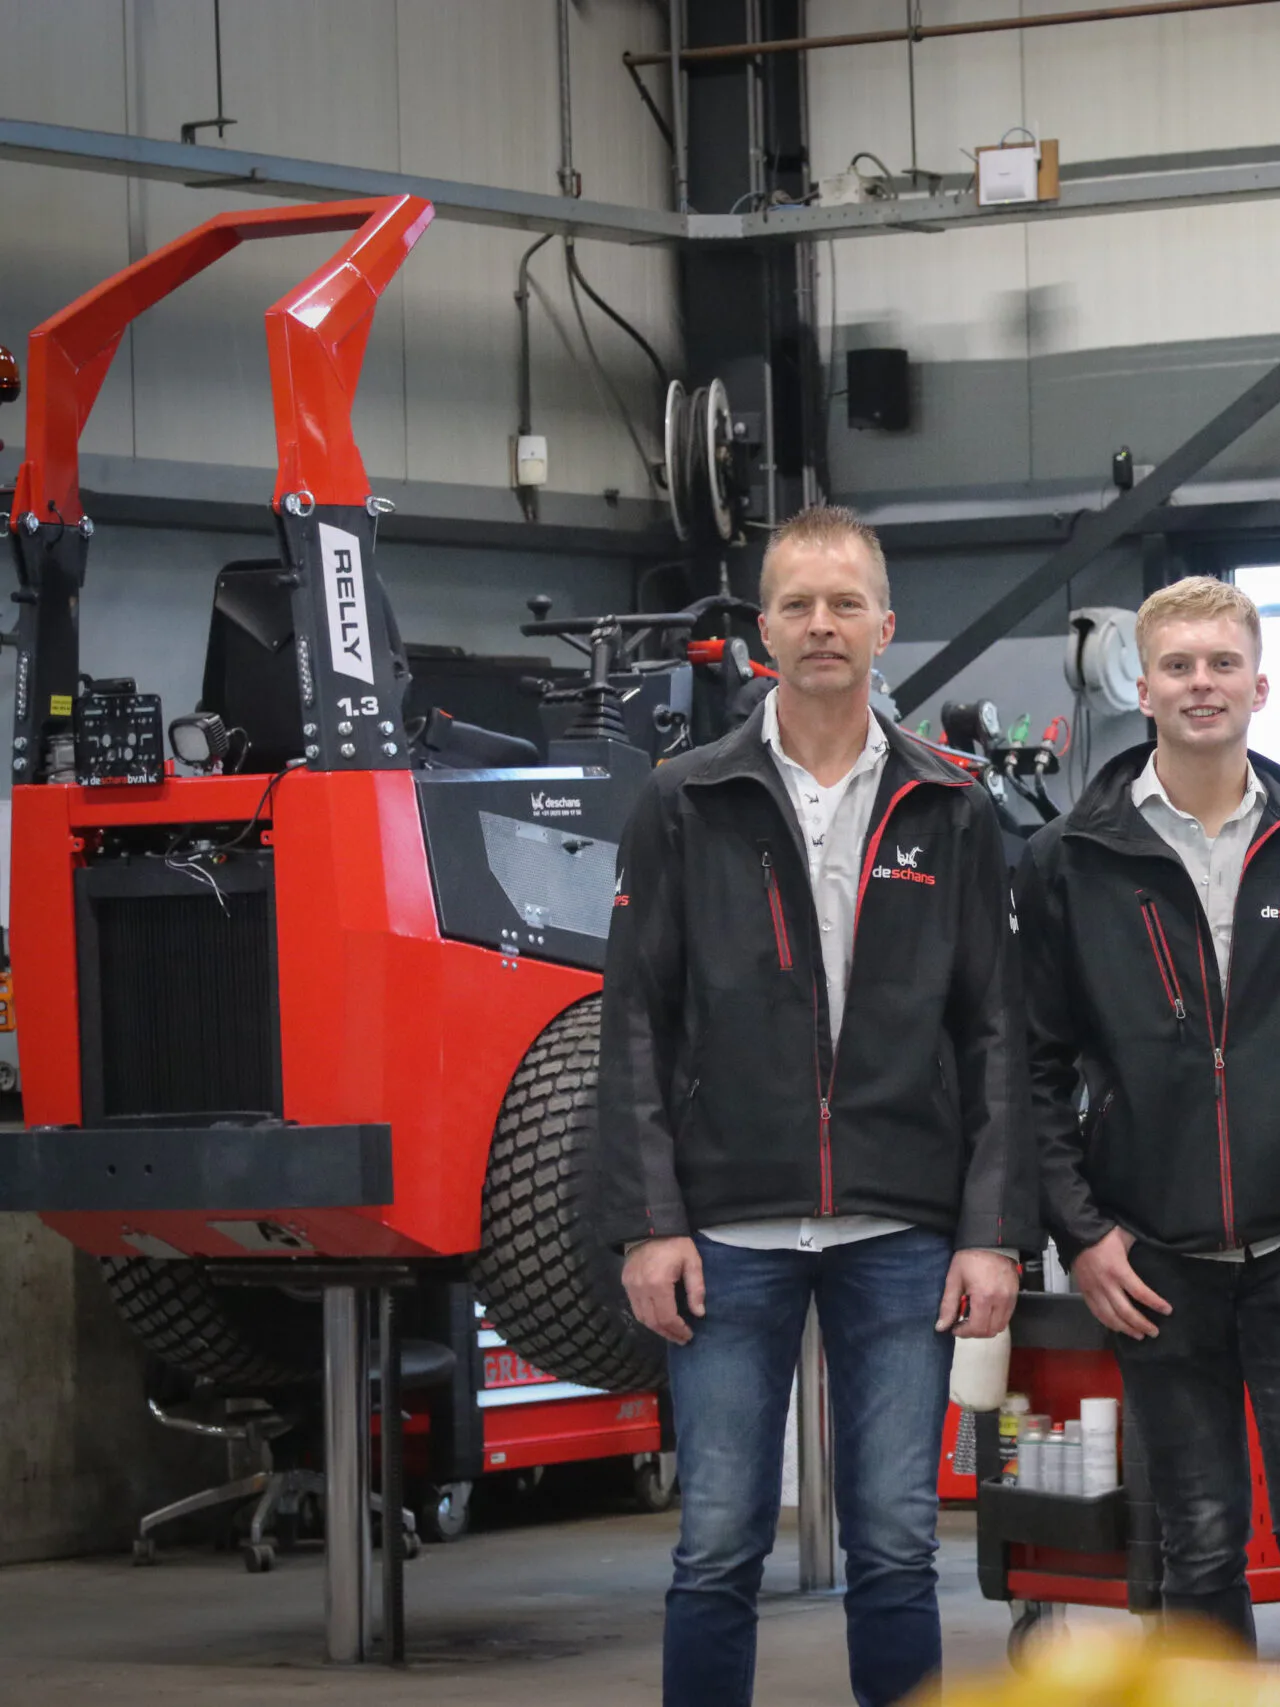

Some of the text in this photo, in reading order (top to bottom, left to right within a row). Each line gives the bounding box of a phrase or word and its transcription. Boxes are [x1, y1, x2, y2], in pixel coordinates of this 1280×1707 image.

[333, 549, 363, 663] RELLY
[337, 696, 380, 717] 1.3
[545, 797, 581, 808] deschans
[872, 865, 936, 886] deschans
